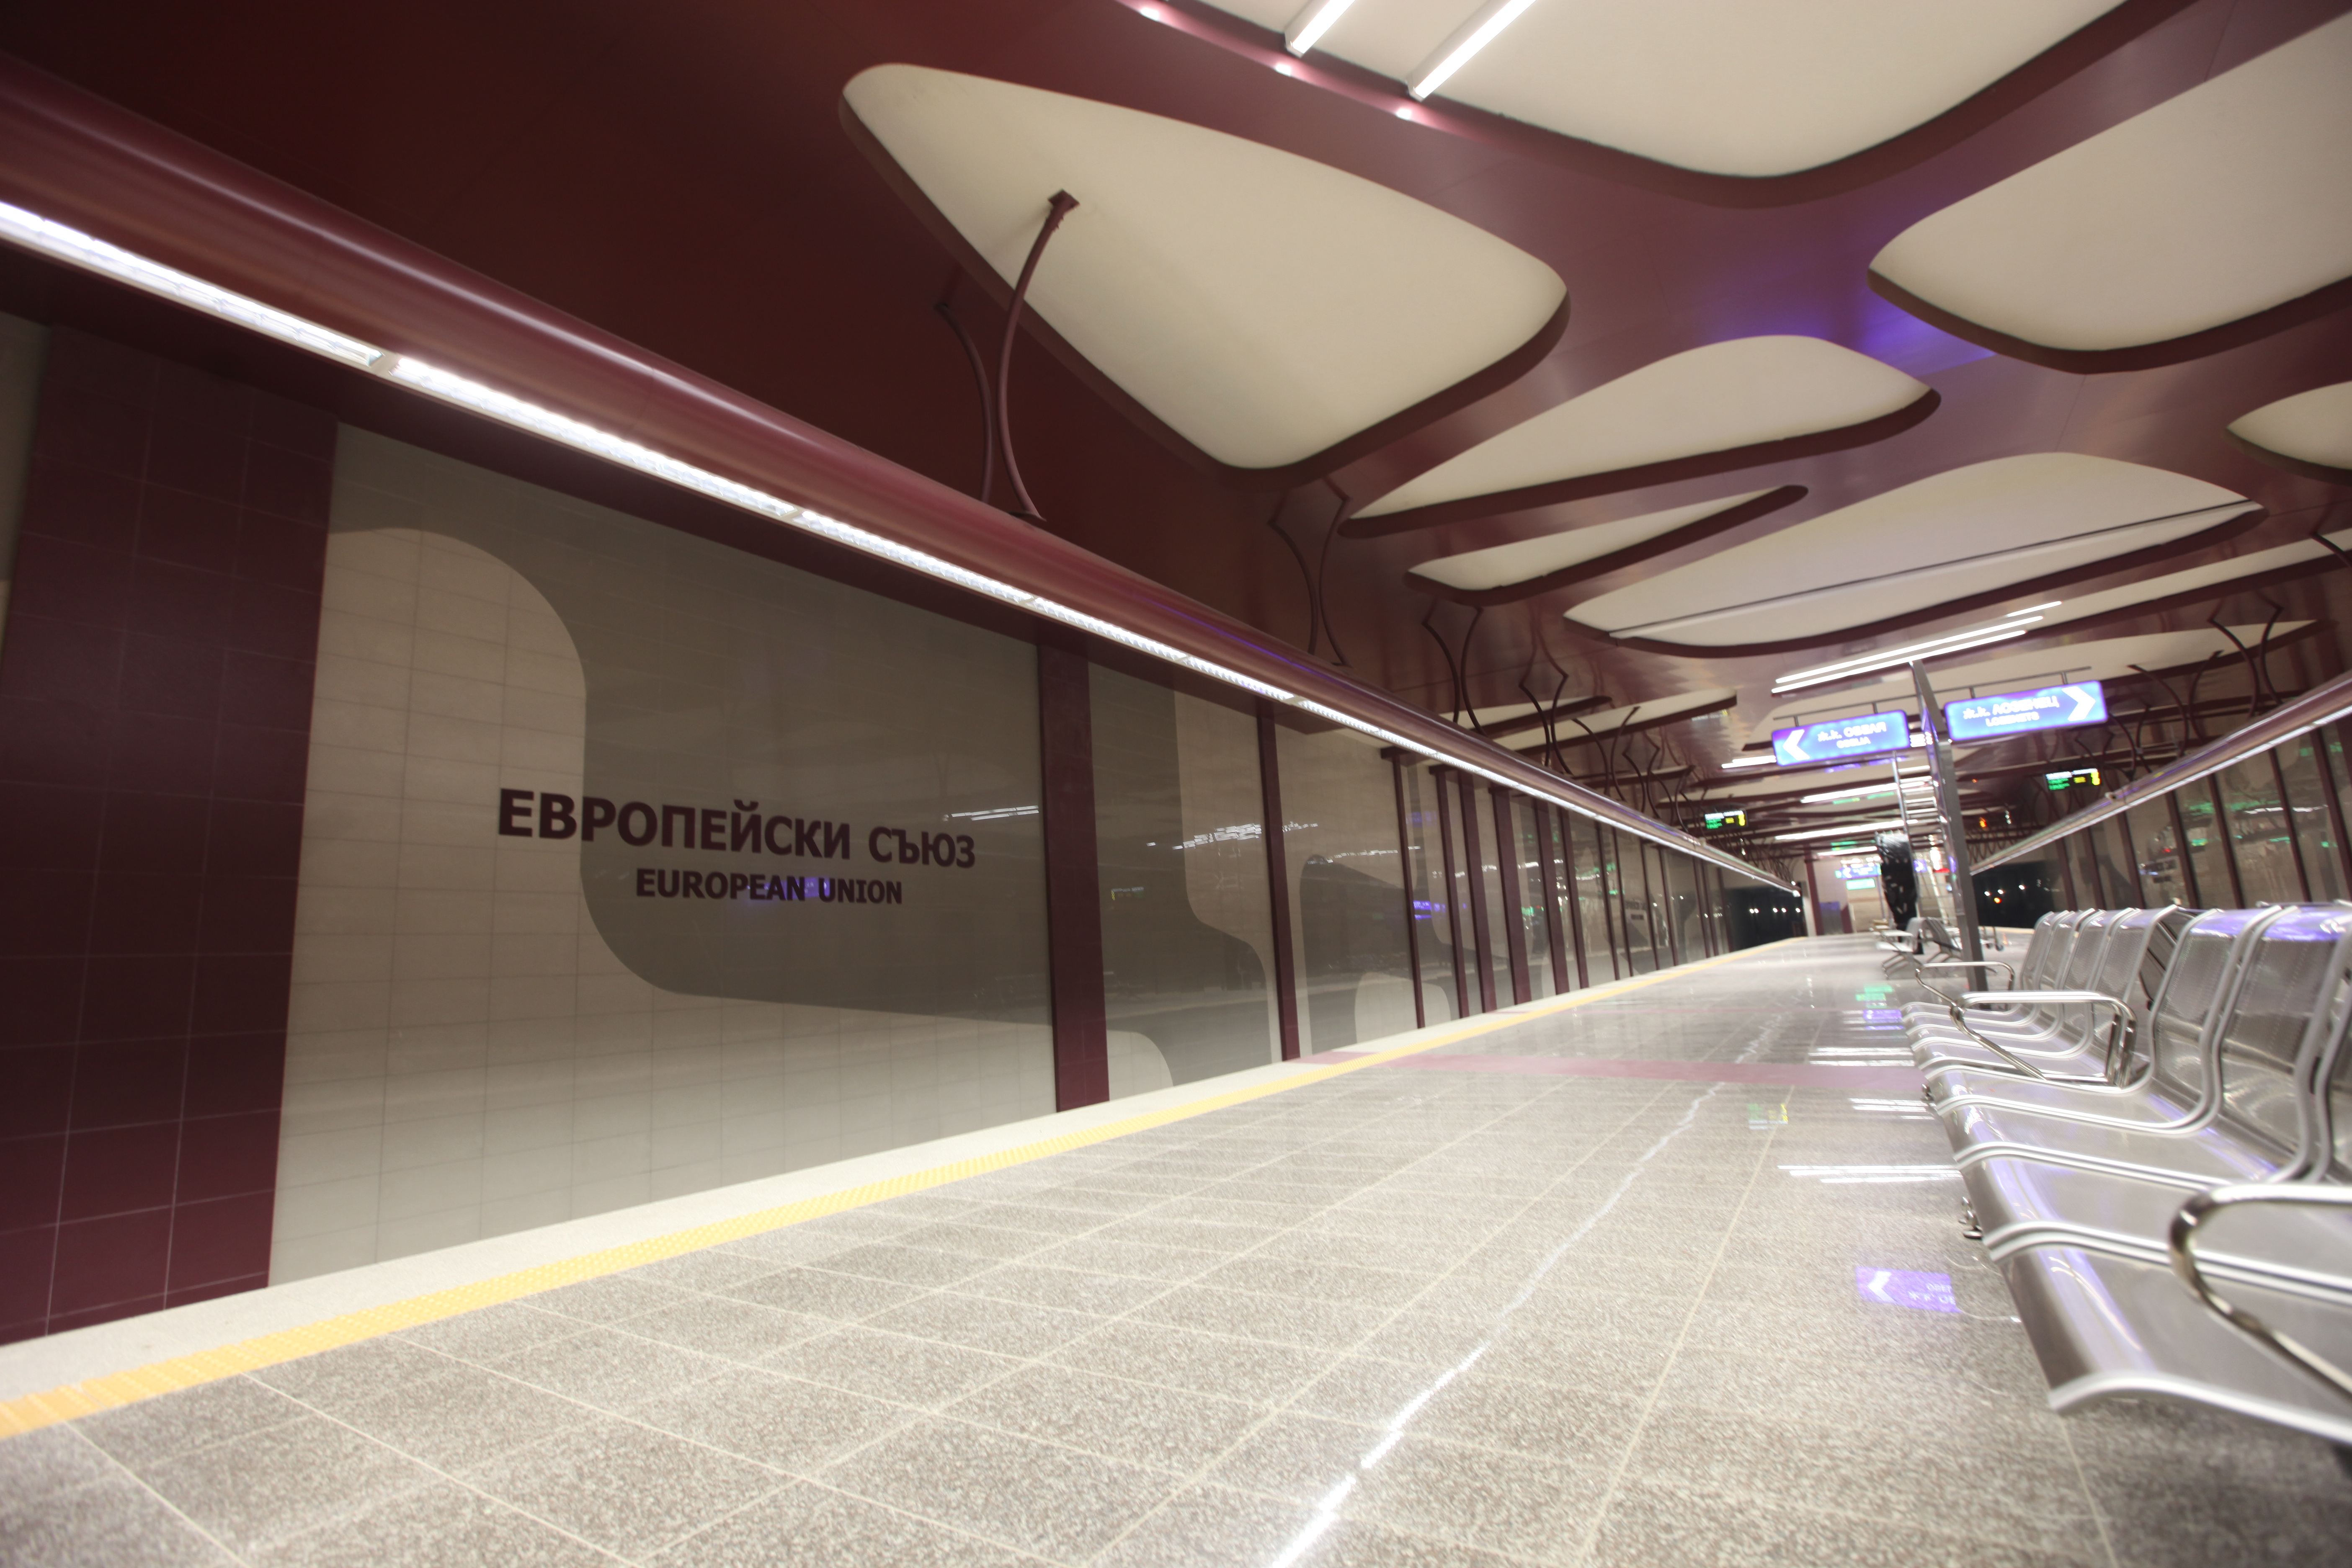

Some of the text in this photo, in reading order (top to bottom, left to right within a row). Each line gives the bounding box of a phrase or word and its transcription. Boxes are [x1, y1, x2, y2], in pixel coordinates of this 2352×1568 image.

[499, 788, 975, 868] ЕВРОПЕЙСКИ СЪЮЗ
[636, 868, 902, 904] EUROPEAN UNION
